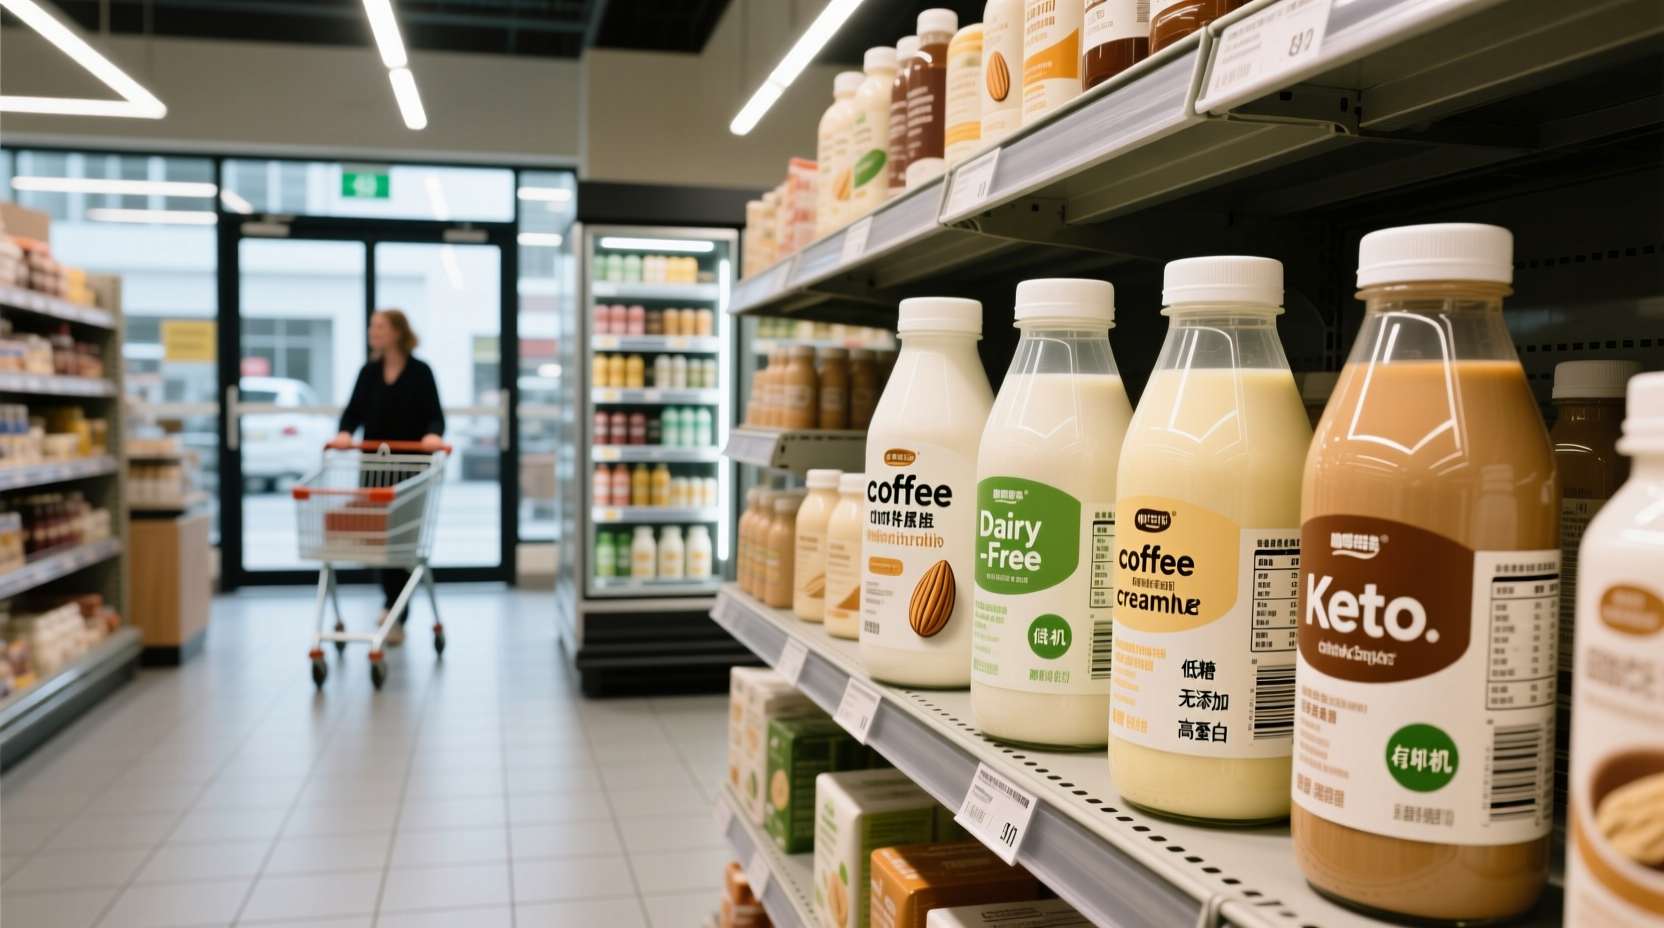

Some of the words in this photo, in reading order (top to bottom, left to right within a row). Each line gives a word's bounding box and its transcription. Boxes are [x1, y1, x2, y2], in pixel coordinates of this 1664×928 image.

[867, 474, 953, 508] coffee
[980, 510, 1042, 548] Dairy
[980, 541, 1042, 571] -Free
[1119, 544, 1195, 577] coffee
[1306, 573, 1440, 643] Keto.
[1181, 659, 1216, 680] 低糖
[1178, 689, 1229, 711] 无添加
